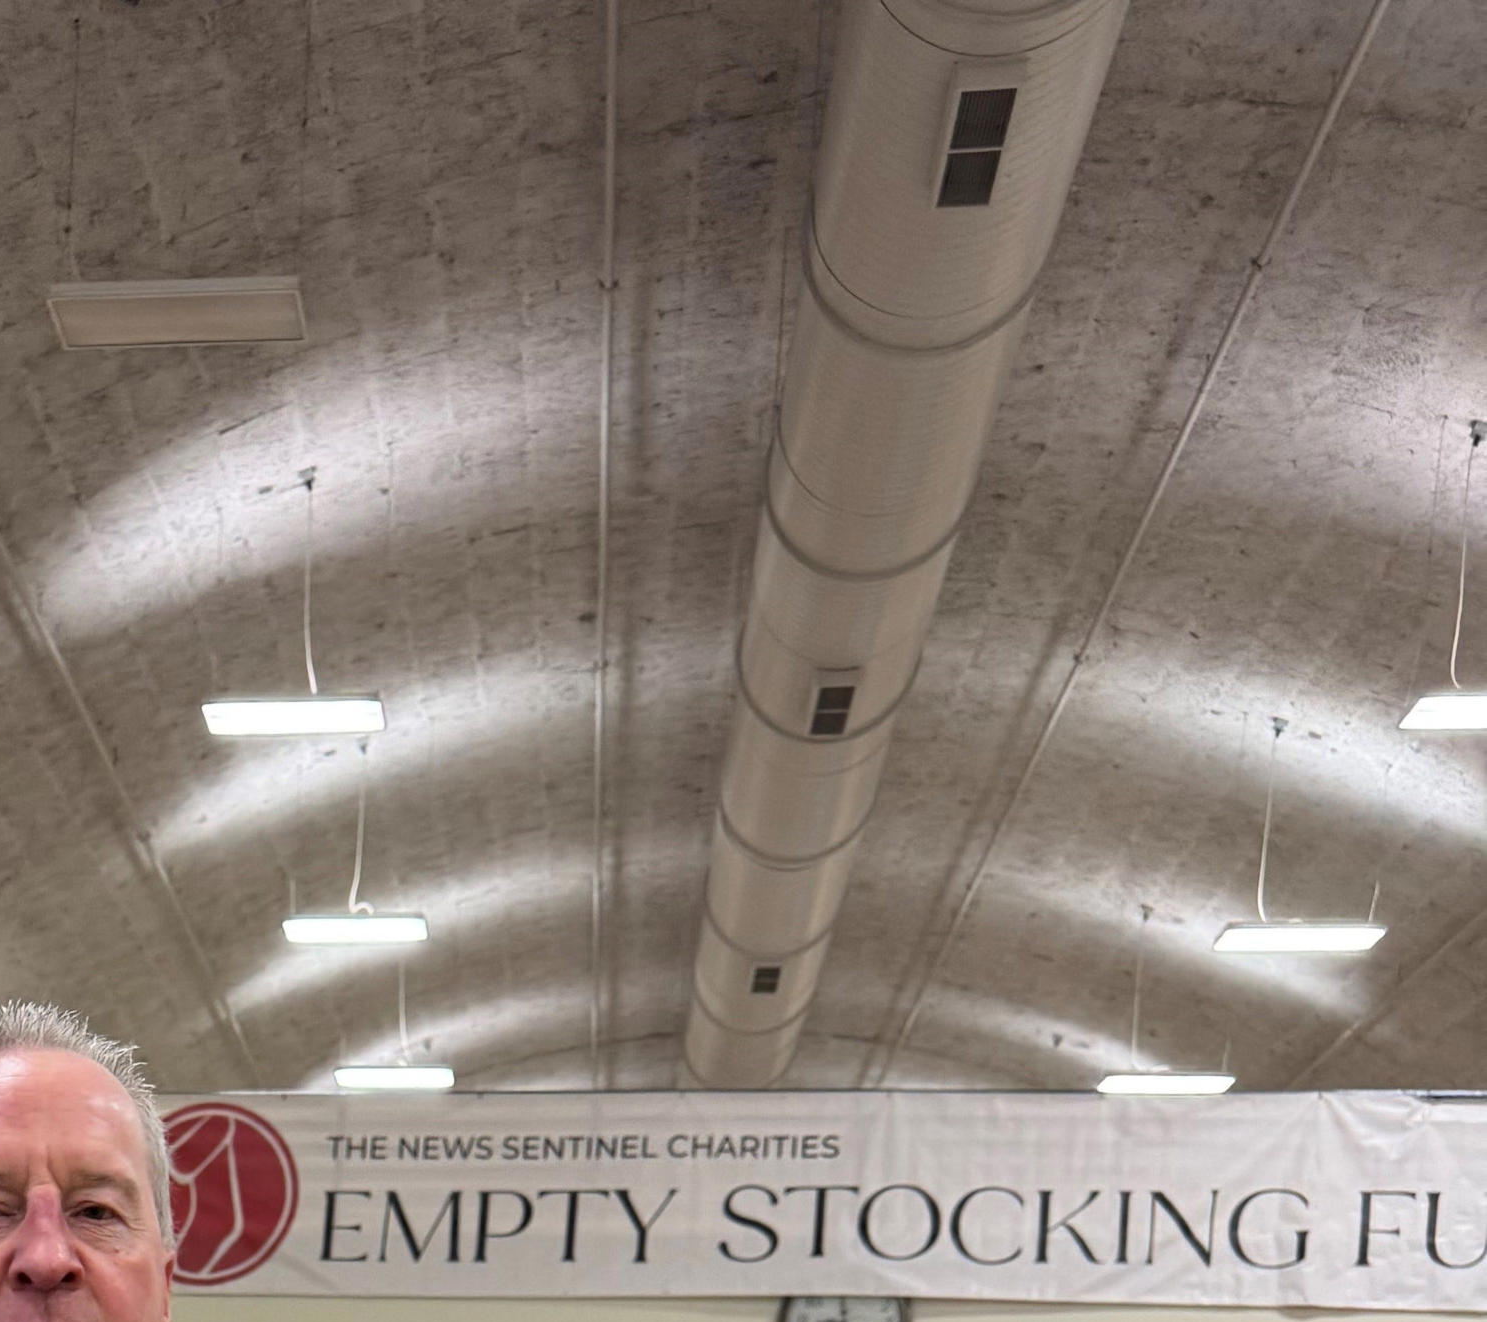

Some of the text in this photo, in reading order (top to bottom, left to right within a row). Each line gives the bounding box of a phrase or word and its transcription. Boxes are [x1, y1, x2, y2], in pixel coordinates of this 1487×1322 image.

[327, 1134, 841, 1161] THE NEWS SENTINEL CHARITIES
[318, 1187, 679, 1264] EMPTY
[717, 1183, 1310, 1270] STOCKING
